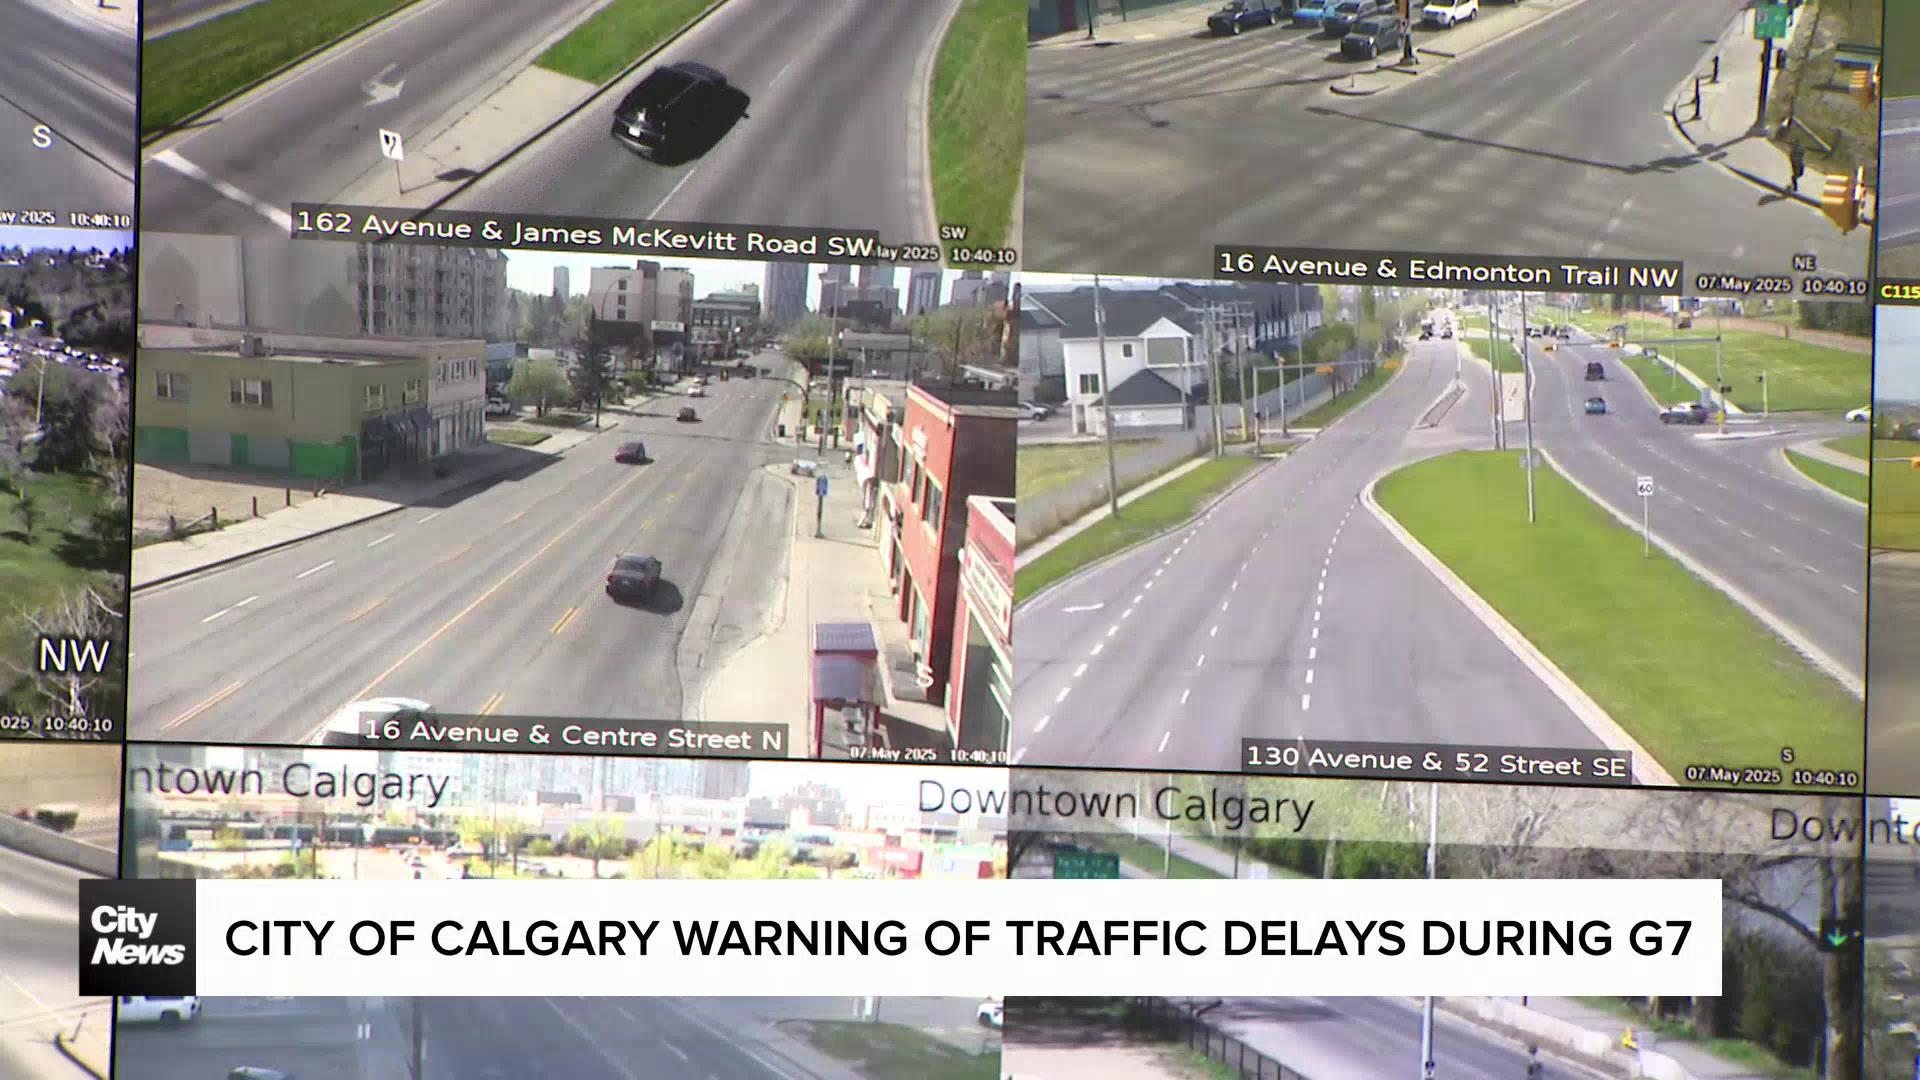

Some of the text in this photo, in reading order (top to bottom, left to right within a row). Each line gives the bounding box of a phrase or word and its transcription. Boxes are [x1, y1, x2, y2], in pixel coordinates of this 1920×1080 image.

[32, 124, 52, 149] S
[20, 210, 55, 225] 2025
[70, 212, 130, 228] 10:40:10
[298, 211, 874, 257] 162 Avenue & James McKevitt Road SW
[941, 226, 967, 239] SW
[902, 246, 938, 260] 2025
[952, 248, 1015, 263] 10:40:10
[1794, 256, 1815, 270] NE
[1220, 252, 1678, 288] 16 Avenue & Edmonton Trail NW
[1755, 277, 1791, 292] 2025
[1803, 279, 1867, 295] 10:40:10
[40, 638, 110, 673] NW
[45, 717, 112, 732] 10:40:10
[365, 719, 781, 750] 16 Avenue & Centre Street N
[904, 748, 937, 761] 2025
[950, 750, 1006, 763] 10:40:10
[1248, 746, 1627, 777] 130 Avenue & 52 Street SE
[1782, 749, 1794, 762] S
[282, 763, 449, 808] Calgary
[1744, 769, 1781, 783] 2025
[1793, 771, 1858, 786] 10:40:10
[918, 779, 1314, 832] Downtown Calgary
